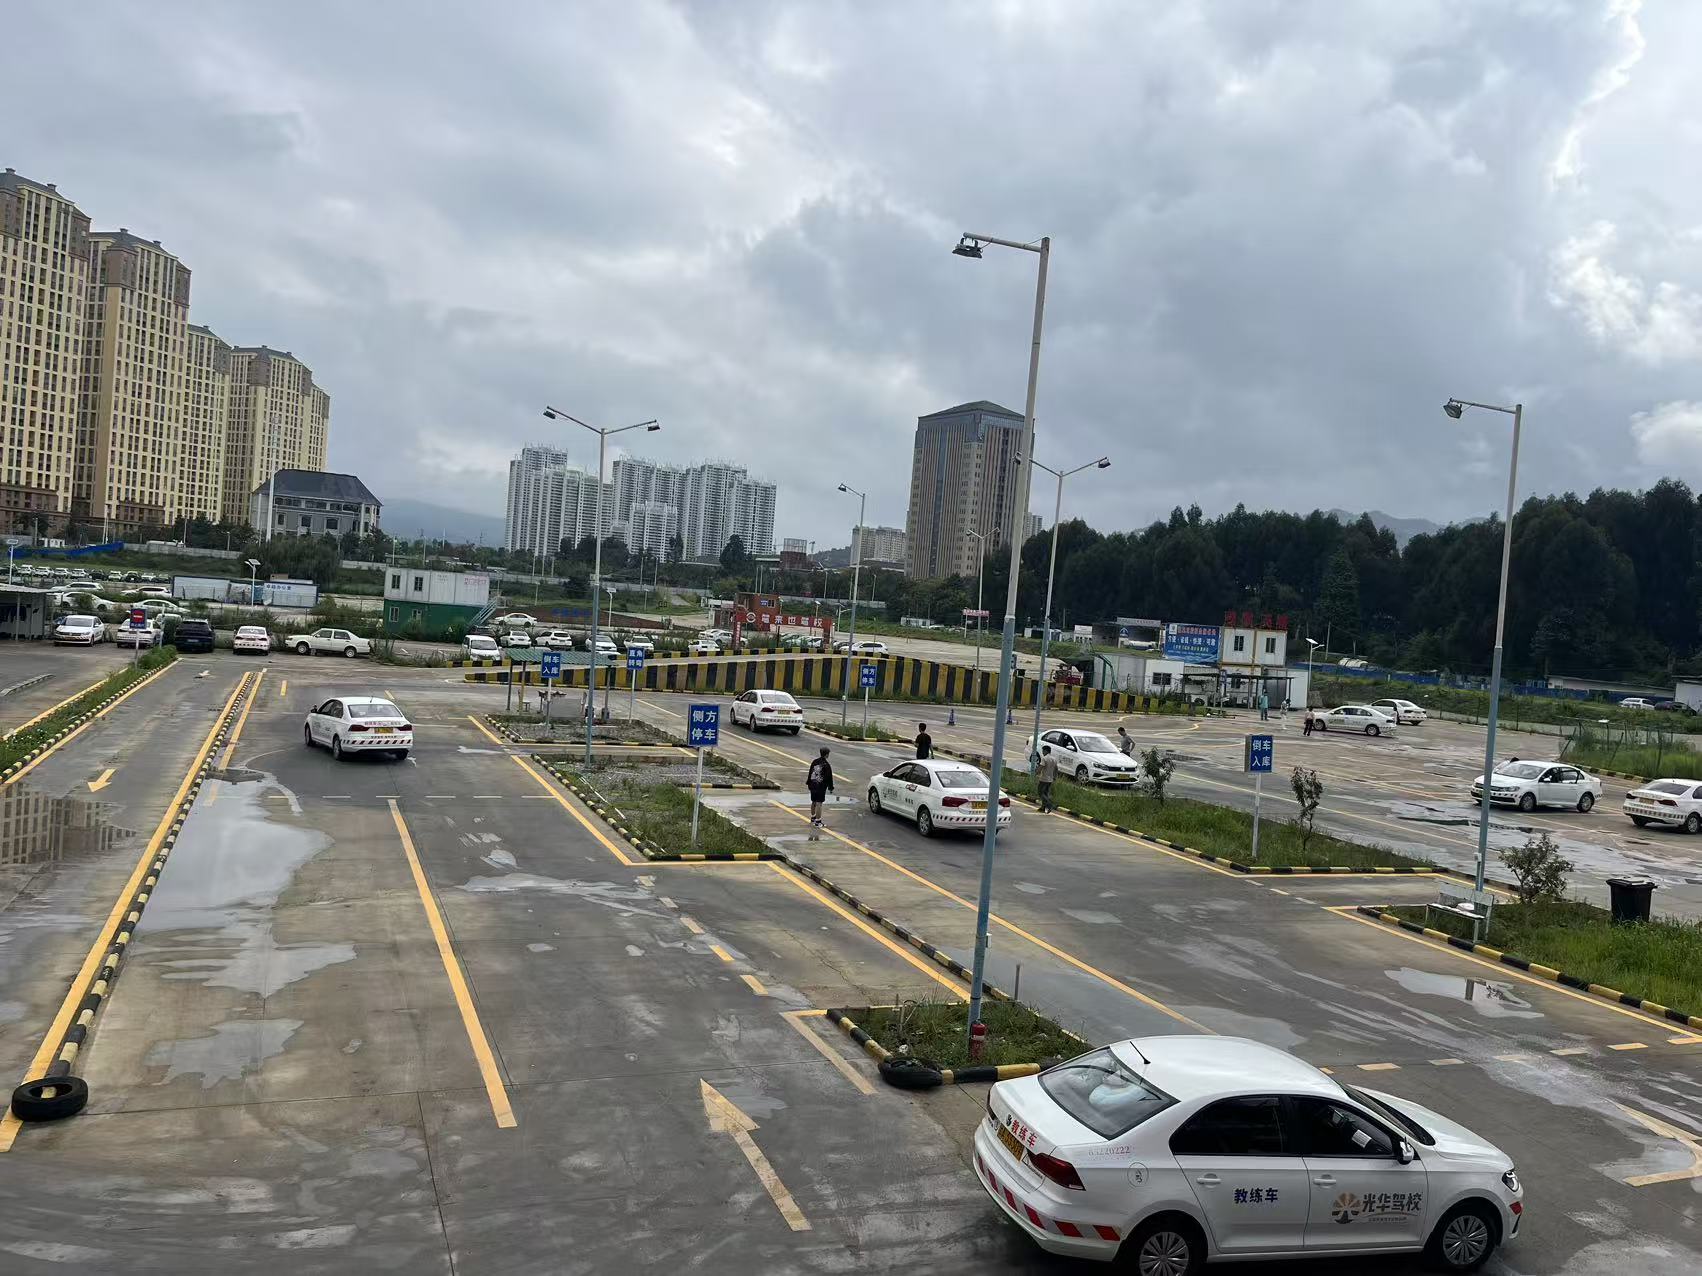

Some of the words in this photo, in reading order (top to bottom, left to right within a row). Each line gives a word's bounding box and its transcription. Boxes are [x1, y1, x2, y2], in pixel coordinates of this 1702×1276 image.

[544, 655, 560, 663] 倒车
[542, 666, 559, 674] 入库
[692, 710, 717, 722] 侧方
[691, 727, 716, 740] 停车
[1252, 739, 1271, 751] 倒车
[1251, 755, 1271, 767] 入库
[1010, 1119, 1038, 1148] 教练车
[1233, 1187, 1279, 1204] 教练车
[1361, 1192, 1423, 1213] 光华驾校
